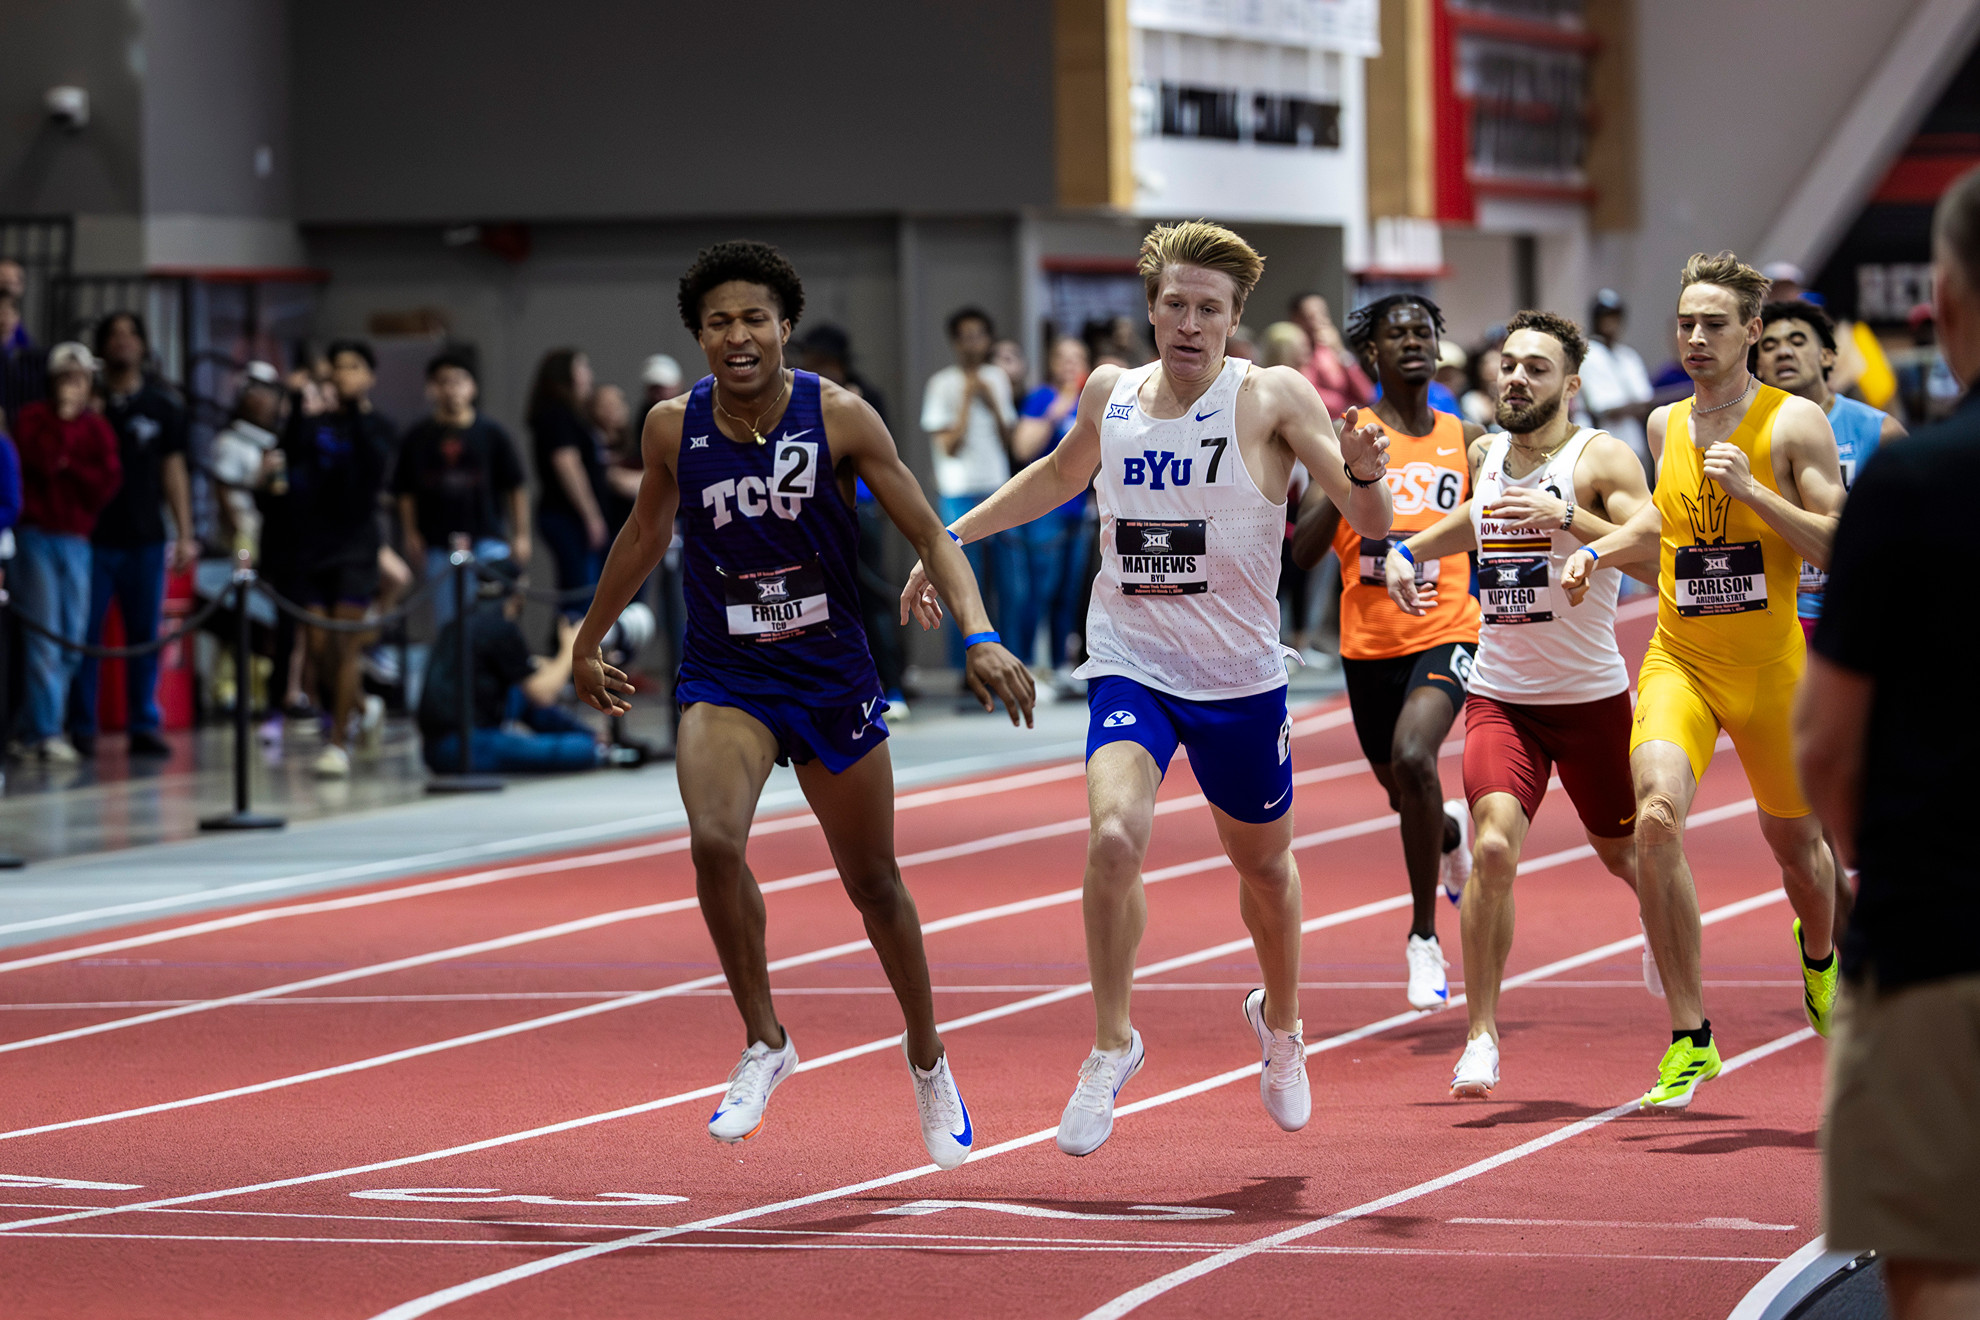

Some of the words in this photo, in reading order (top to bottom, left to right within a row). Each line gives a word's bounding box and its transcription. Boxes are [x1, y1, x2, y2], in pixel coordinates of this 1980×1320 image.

[777, 446, 809, 494] 2
[1123, 450, 1192, 490] BYU
[1201, 437, 1227, 483] 7
[1437, 473, 1458, 510] 6
[702, 476, 801, 530] TCU
[1122, 556, 1197, 573] MATHEWS
[1150, 574, 1165, 583] BYU
[1688, 576, 1753, 596] CARLSON
[1488, 588, 1536, 605] KIPYEGO
[1696, 594, 1725, 604] ARIZONA
[1725, 593, 1746, 602] STATE
[751, 600, 803, 623] FRILOT
[1510, 605, 1527, 613] STATE
[771, 622, 787, 631] TCU
